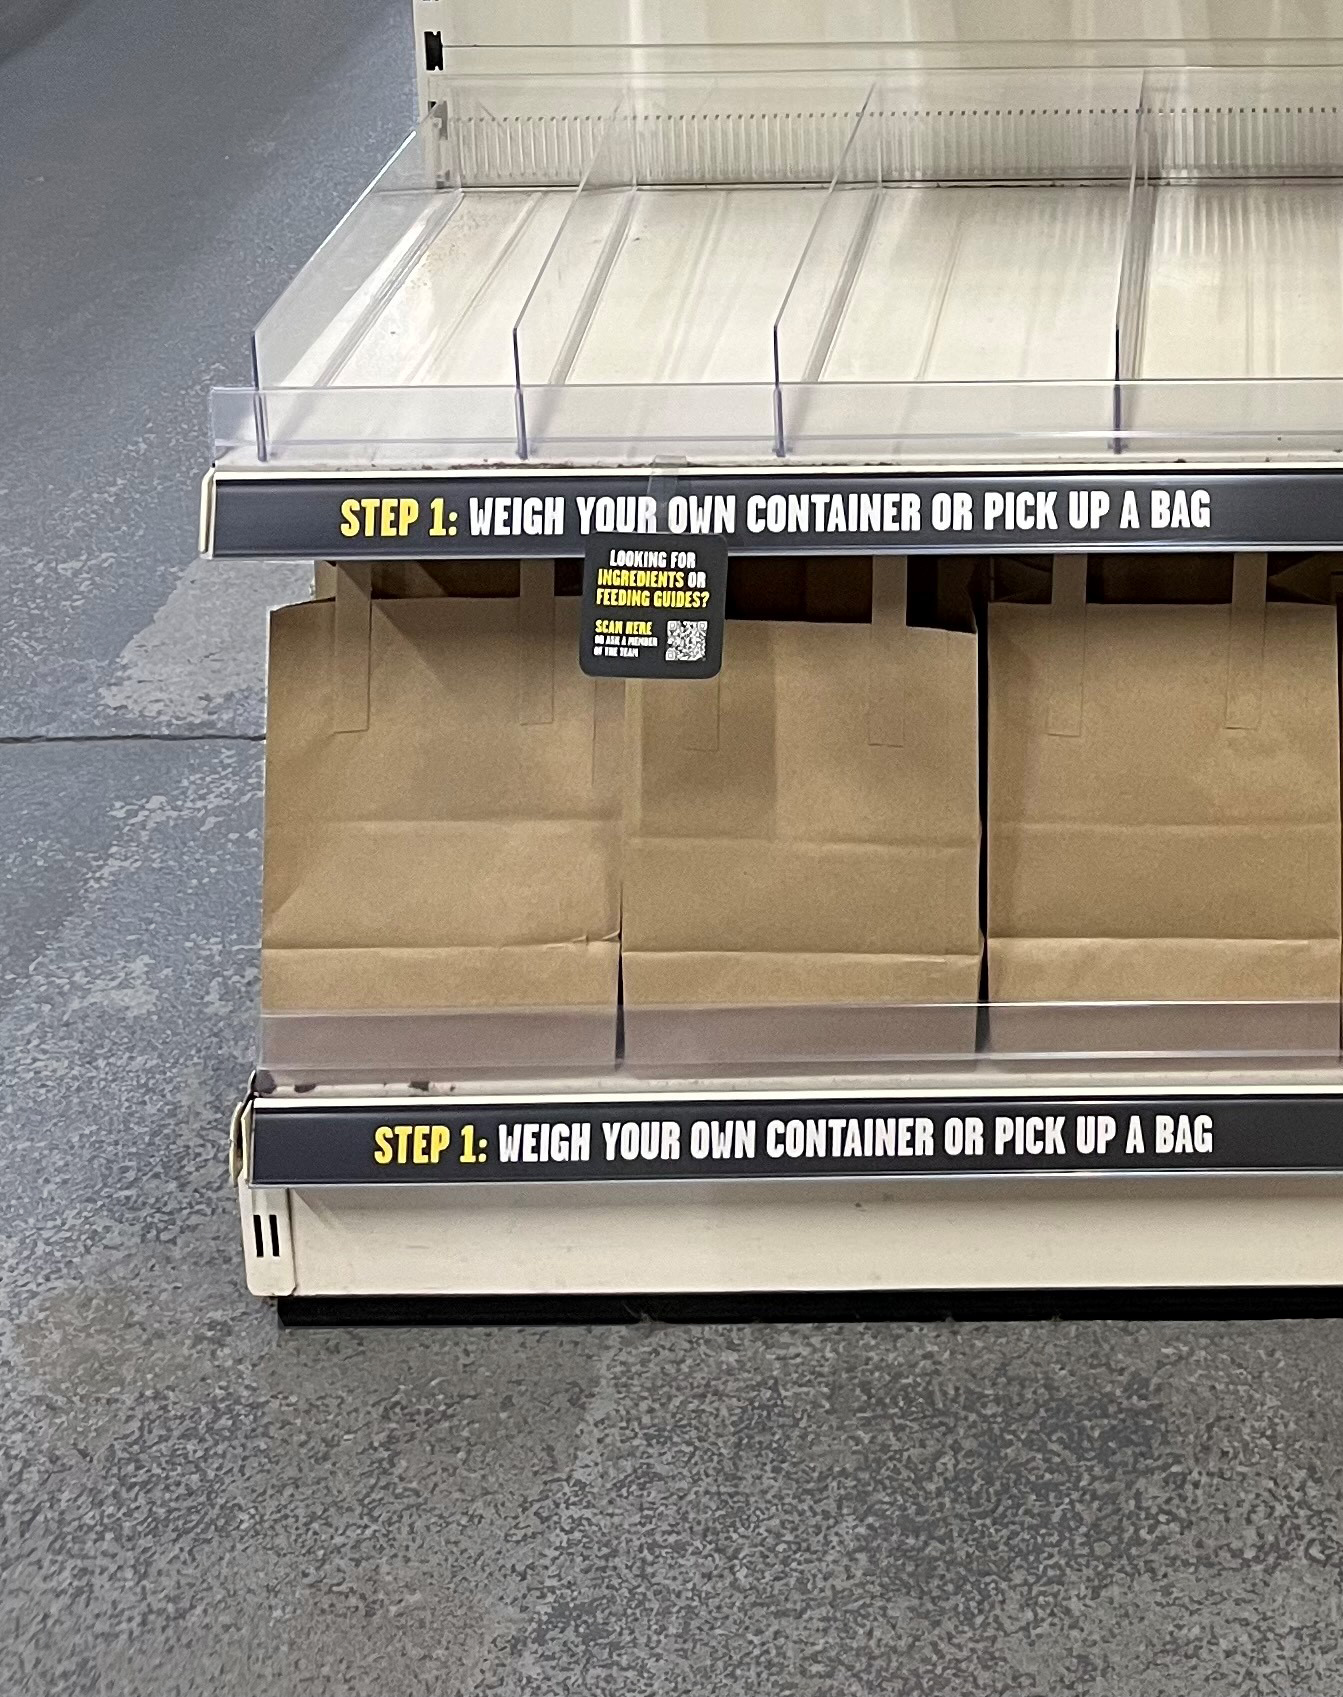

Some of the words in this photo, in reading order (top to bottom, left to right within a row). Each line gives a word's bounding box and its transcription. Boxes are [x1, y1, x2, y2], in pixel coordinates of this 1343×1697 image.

[340, 498, 419, 538] STEP
[429, 497, 458, 536] 1:
[469, 496, 565, 536] WEIGH
[575, 496, 658, 535] YOUR
[666, 494, 736, 535] OWN
[746, 492, 921, 533] CONTAINER
[931, 492, 973, 531] OR
[984, 491, 1059, 531] PICK
[1068, 490, 1110, 530] UP
[1119, 490, 1141, 529] A
[1150, 489, 1211, 529] BAG
[609, 549, 668, 569] LOOKING
[669, 550, 696, 569] FOR
[596, 568, 685, 588] INGREDIENTS
[687, 571, 707, 589] OR
[595, 587, 651, 607] FEEDING
[652, 590, 711, 608] GUIDES?
[374, 1125, 451, 1164] STEP
[459, 1124, 488, 1163] 1:
[498, 1122, 591, 1163] WEIGH
[601, 1121, 681, 1161] YOUR
[690, 1119, 756, 1160] OWN
[766, 1117, 934, 1158] CONTAINER
[944, 1117, 984, 1156] OR
[994, 1116, 1066, 1155] PICK
[1076, 1115, 1117, 1155] UP
[1125, 1115, 1145, 1154] A
[1155, 1114, 1213, 1154] BAG
